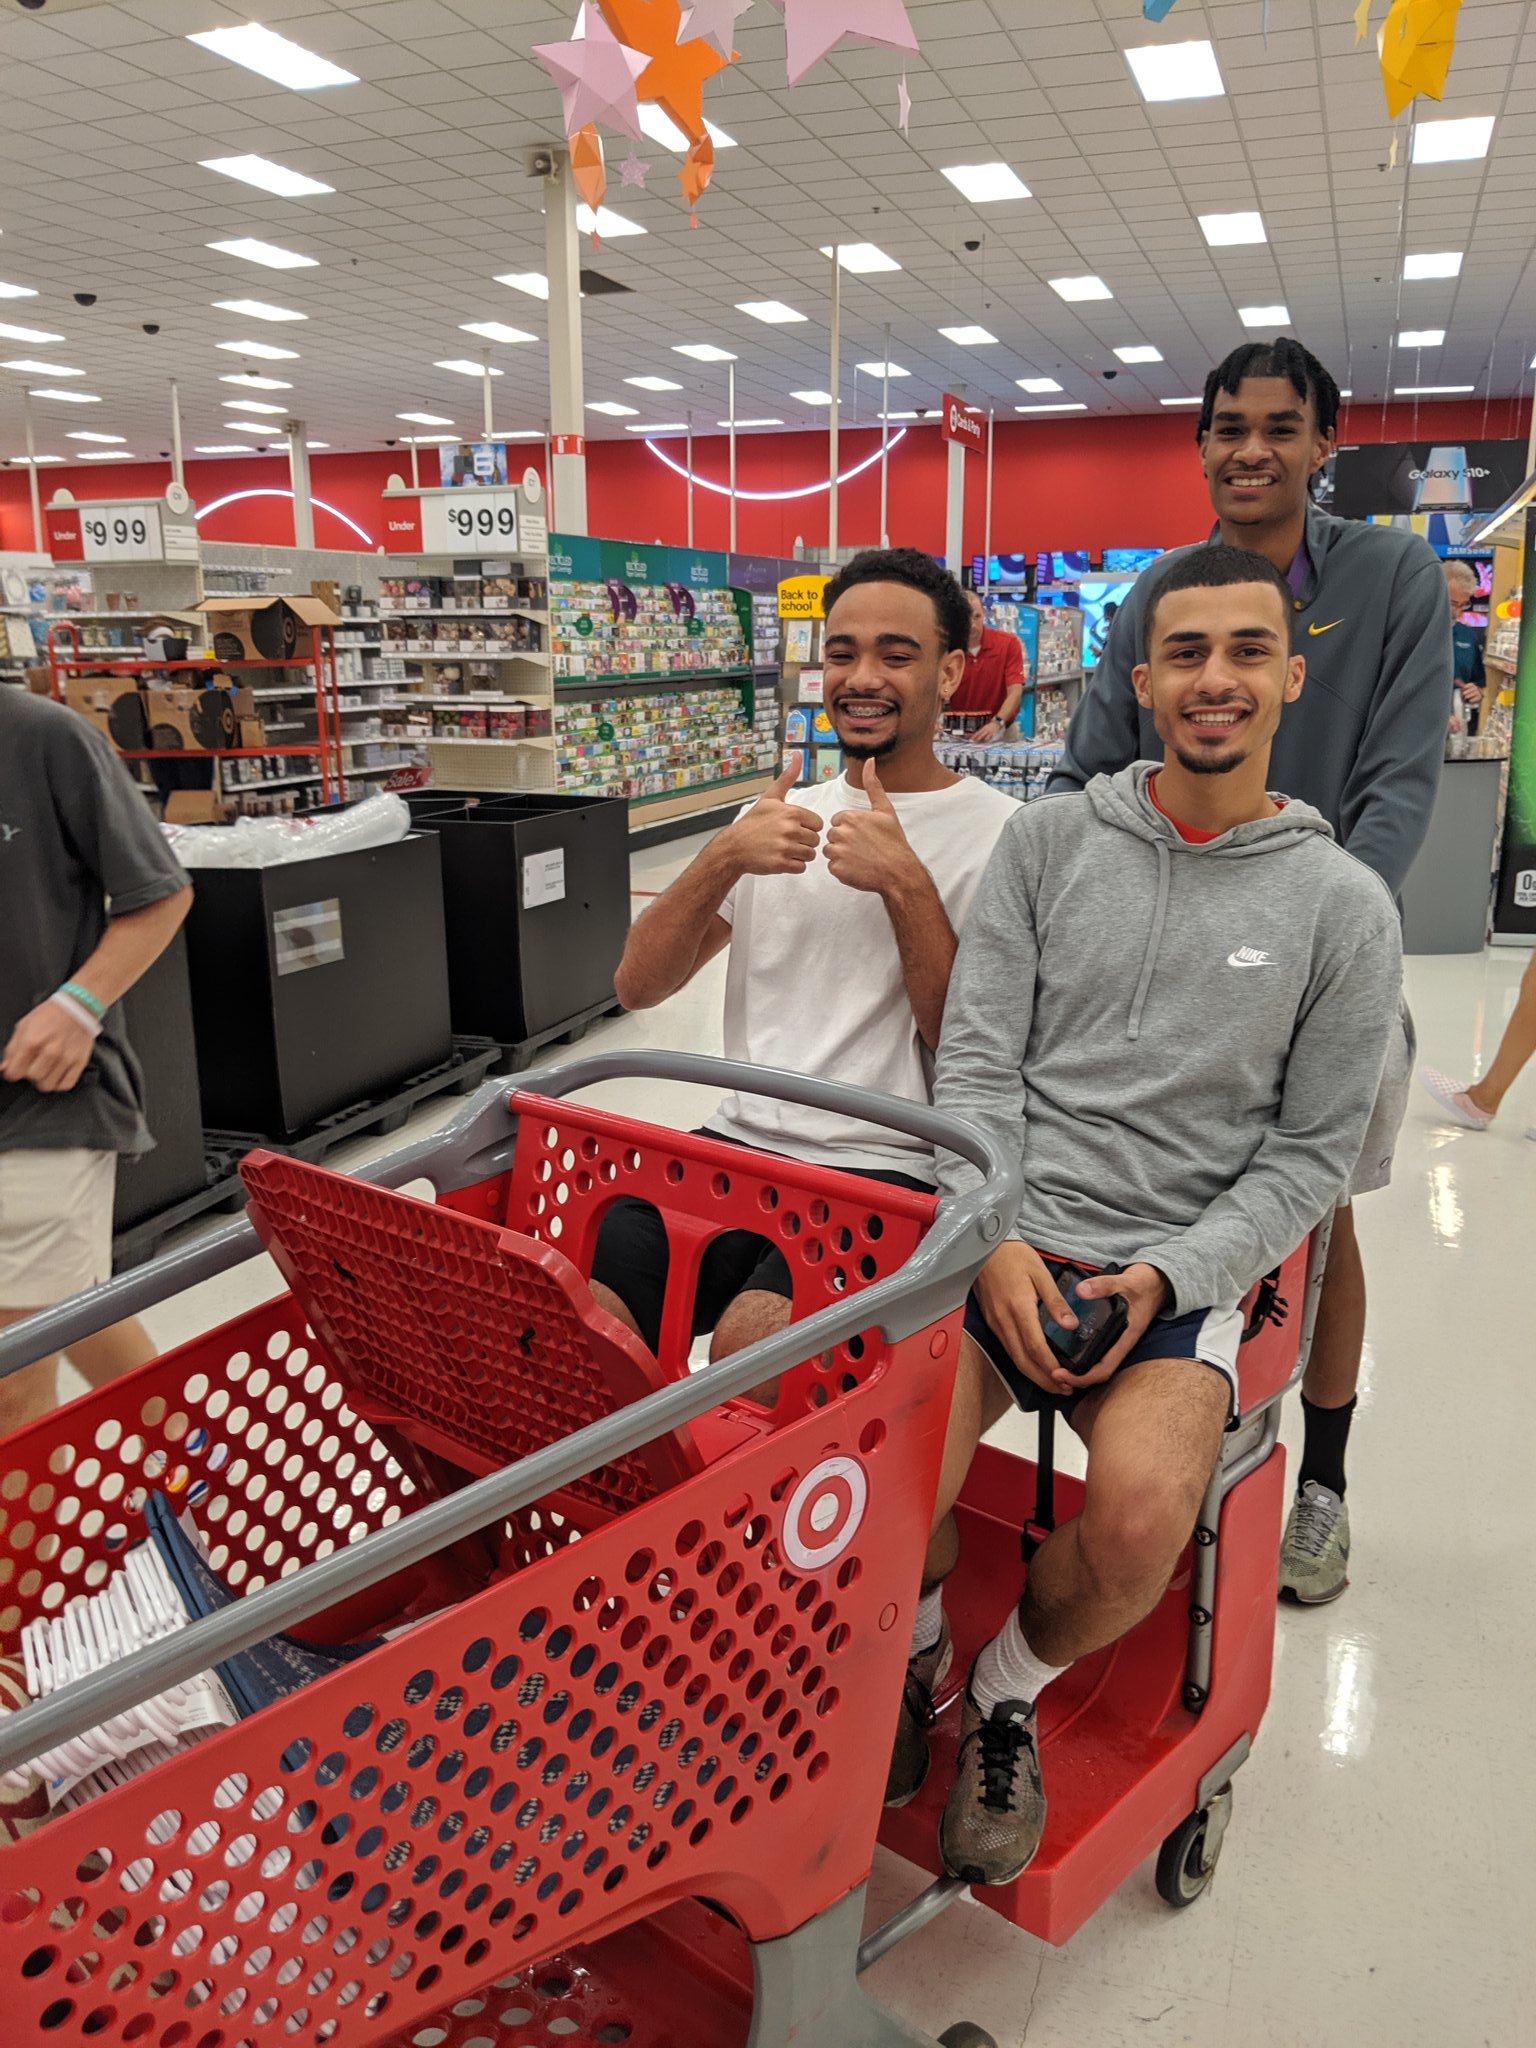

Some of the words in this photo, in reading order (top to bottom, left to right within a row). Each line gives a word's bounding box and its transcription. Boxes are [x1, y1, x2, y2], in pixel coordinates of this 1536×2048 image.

[1408, 468, 1460, 481] Galaxy
[1463, 467, 1491, 478] S10+
[388, 521, 416, 532] Under
[54, 531, 77, 541] Under
[1446, 547, 1492, 555] SAMSUNG
[780, 589, 804, 600] Back
[807, 589, 818, 600] to
[780, 601, 813, 611] school
[386, 769, 422, 788] Sale!
[1236, 945, 1270, 963] NIKE
